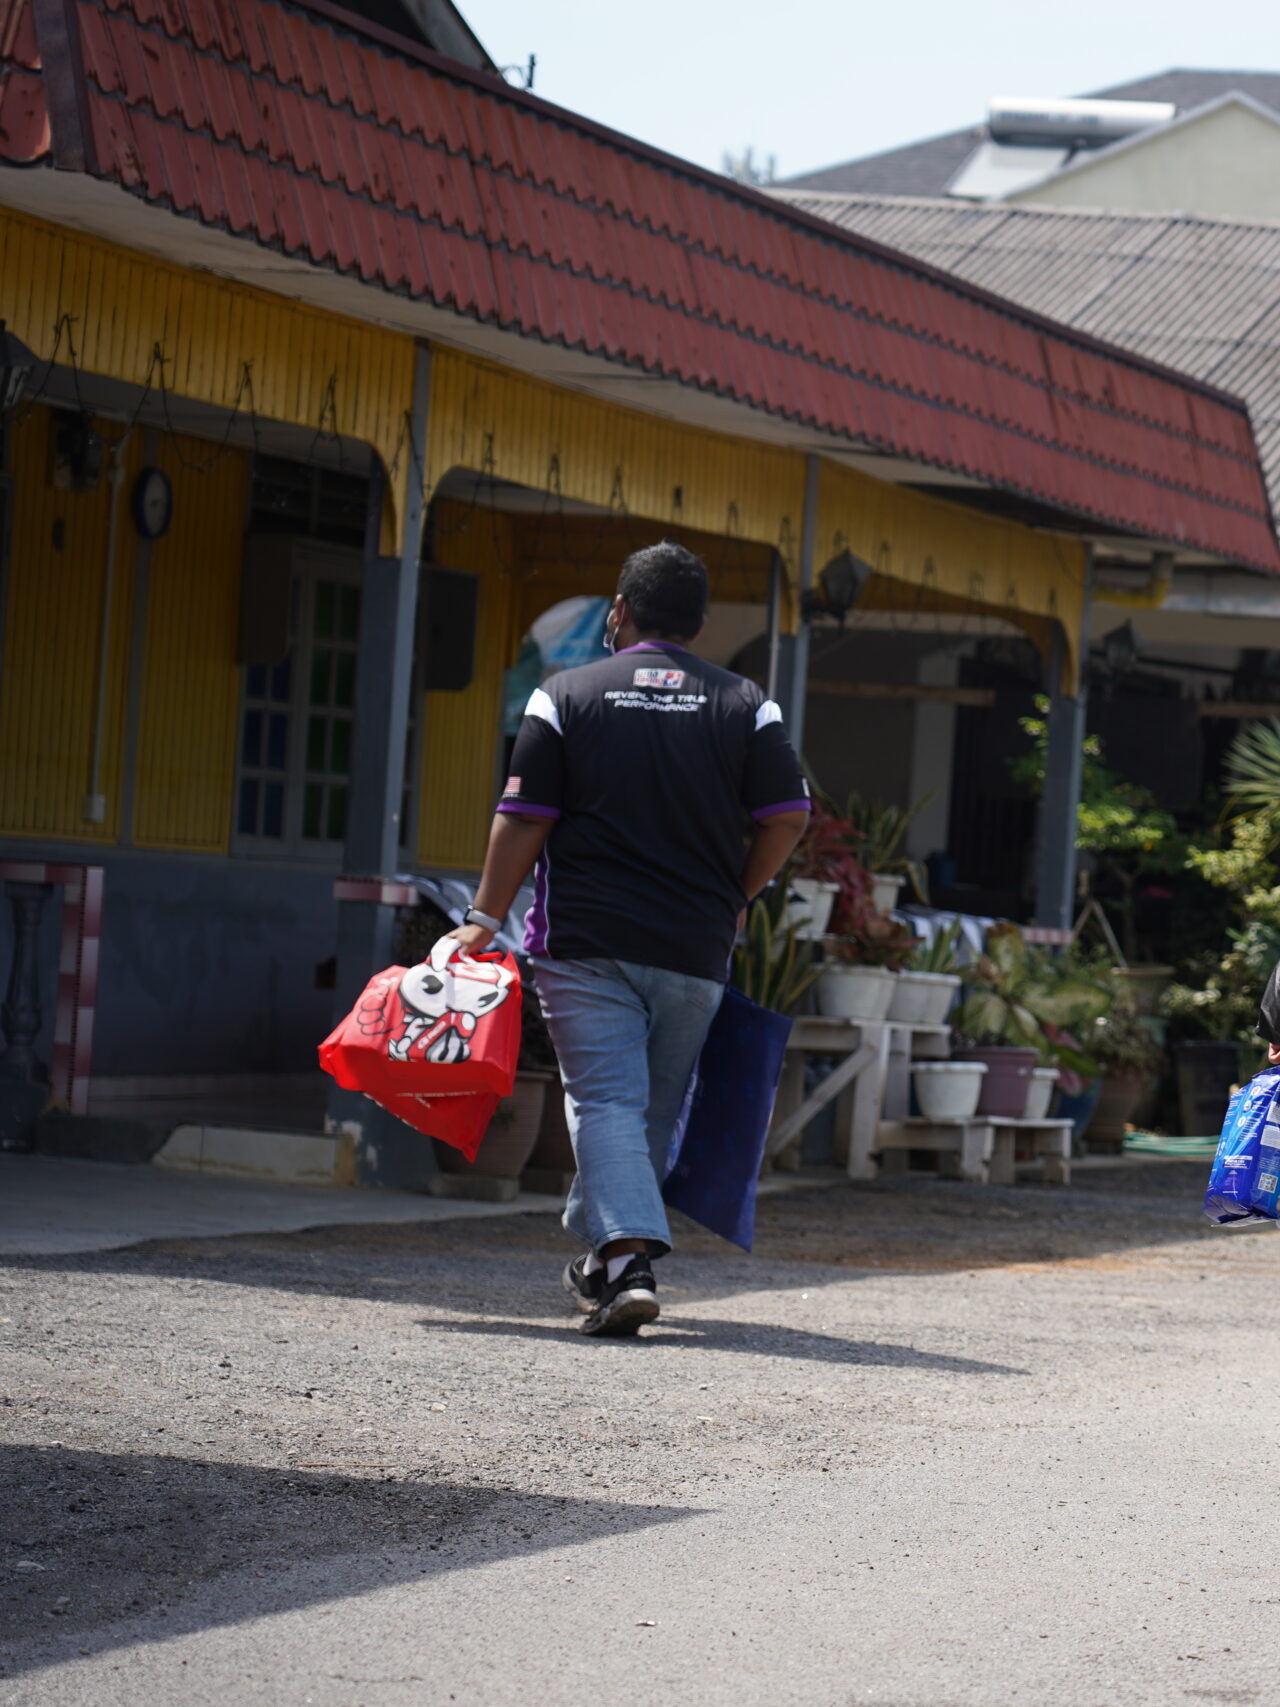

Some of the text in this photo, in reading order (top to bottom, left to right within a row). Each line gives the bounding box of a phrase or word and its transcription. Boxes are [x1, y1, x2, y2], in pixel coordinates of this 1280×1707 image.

[652, 693, 674, 703] THE
[677, 694, 708, 704] TRUE
[614, 700, 700, 712] PERFORMANCE
